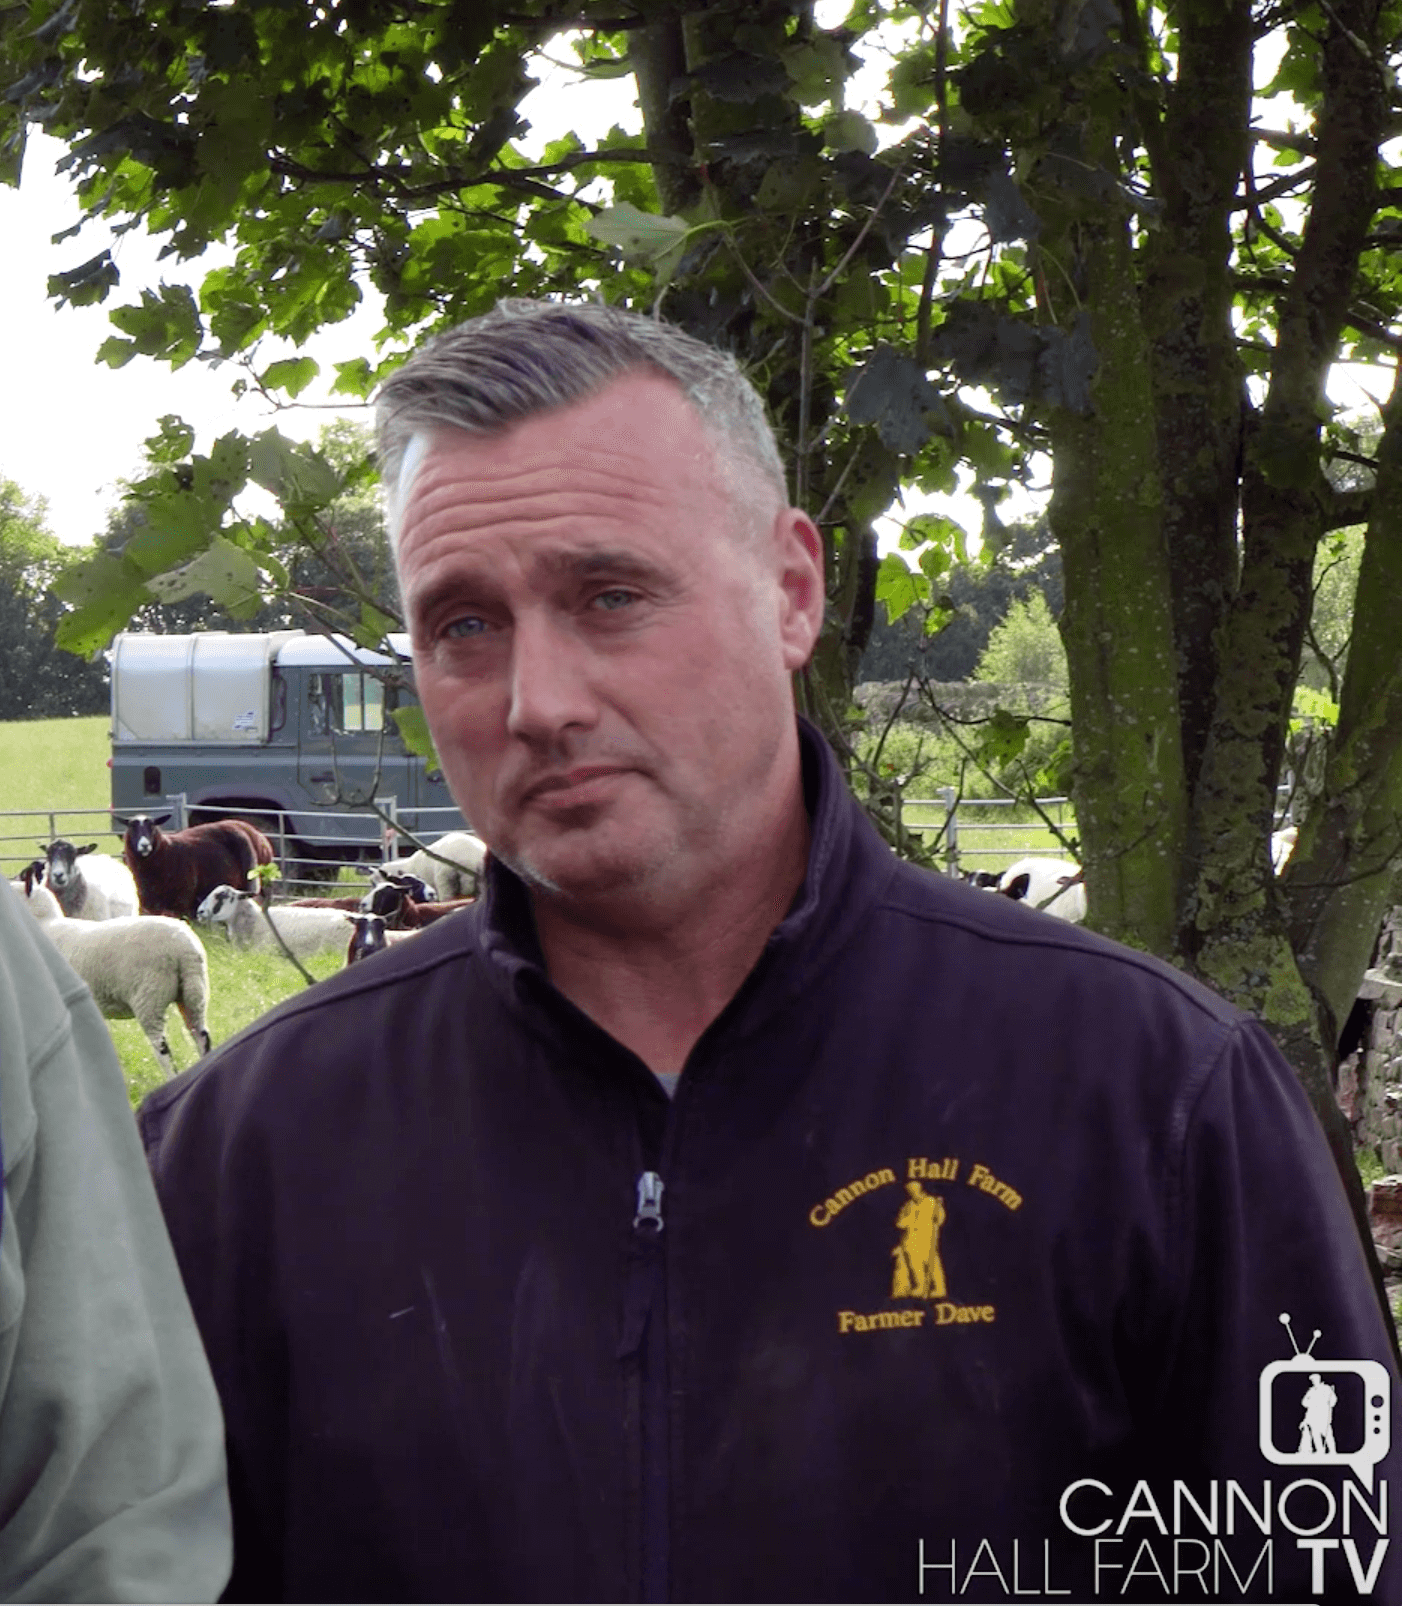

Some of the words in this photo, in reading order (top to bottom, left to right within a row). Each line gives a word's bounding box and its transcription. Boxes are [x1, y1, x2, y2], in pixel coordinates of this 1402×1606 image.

[808, 1167, 897, 1227] Cannon
[907, 1156, 960, 1181] Hall
[967, 1163, 1024, 1211] Farm
[837, 1310, 926, 1333] Farmer
[934, 1302, 996, 1326] Dave
